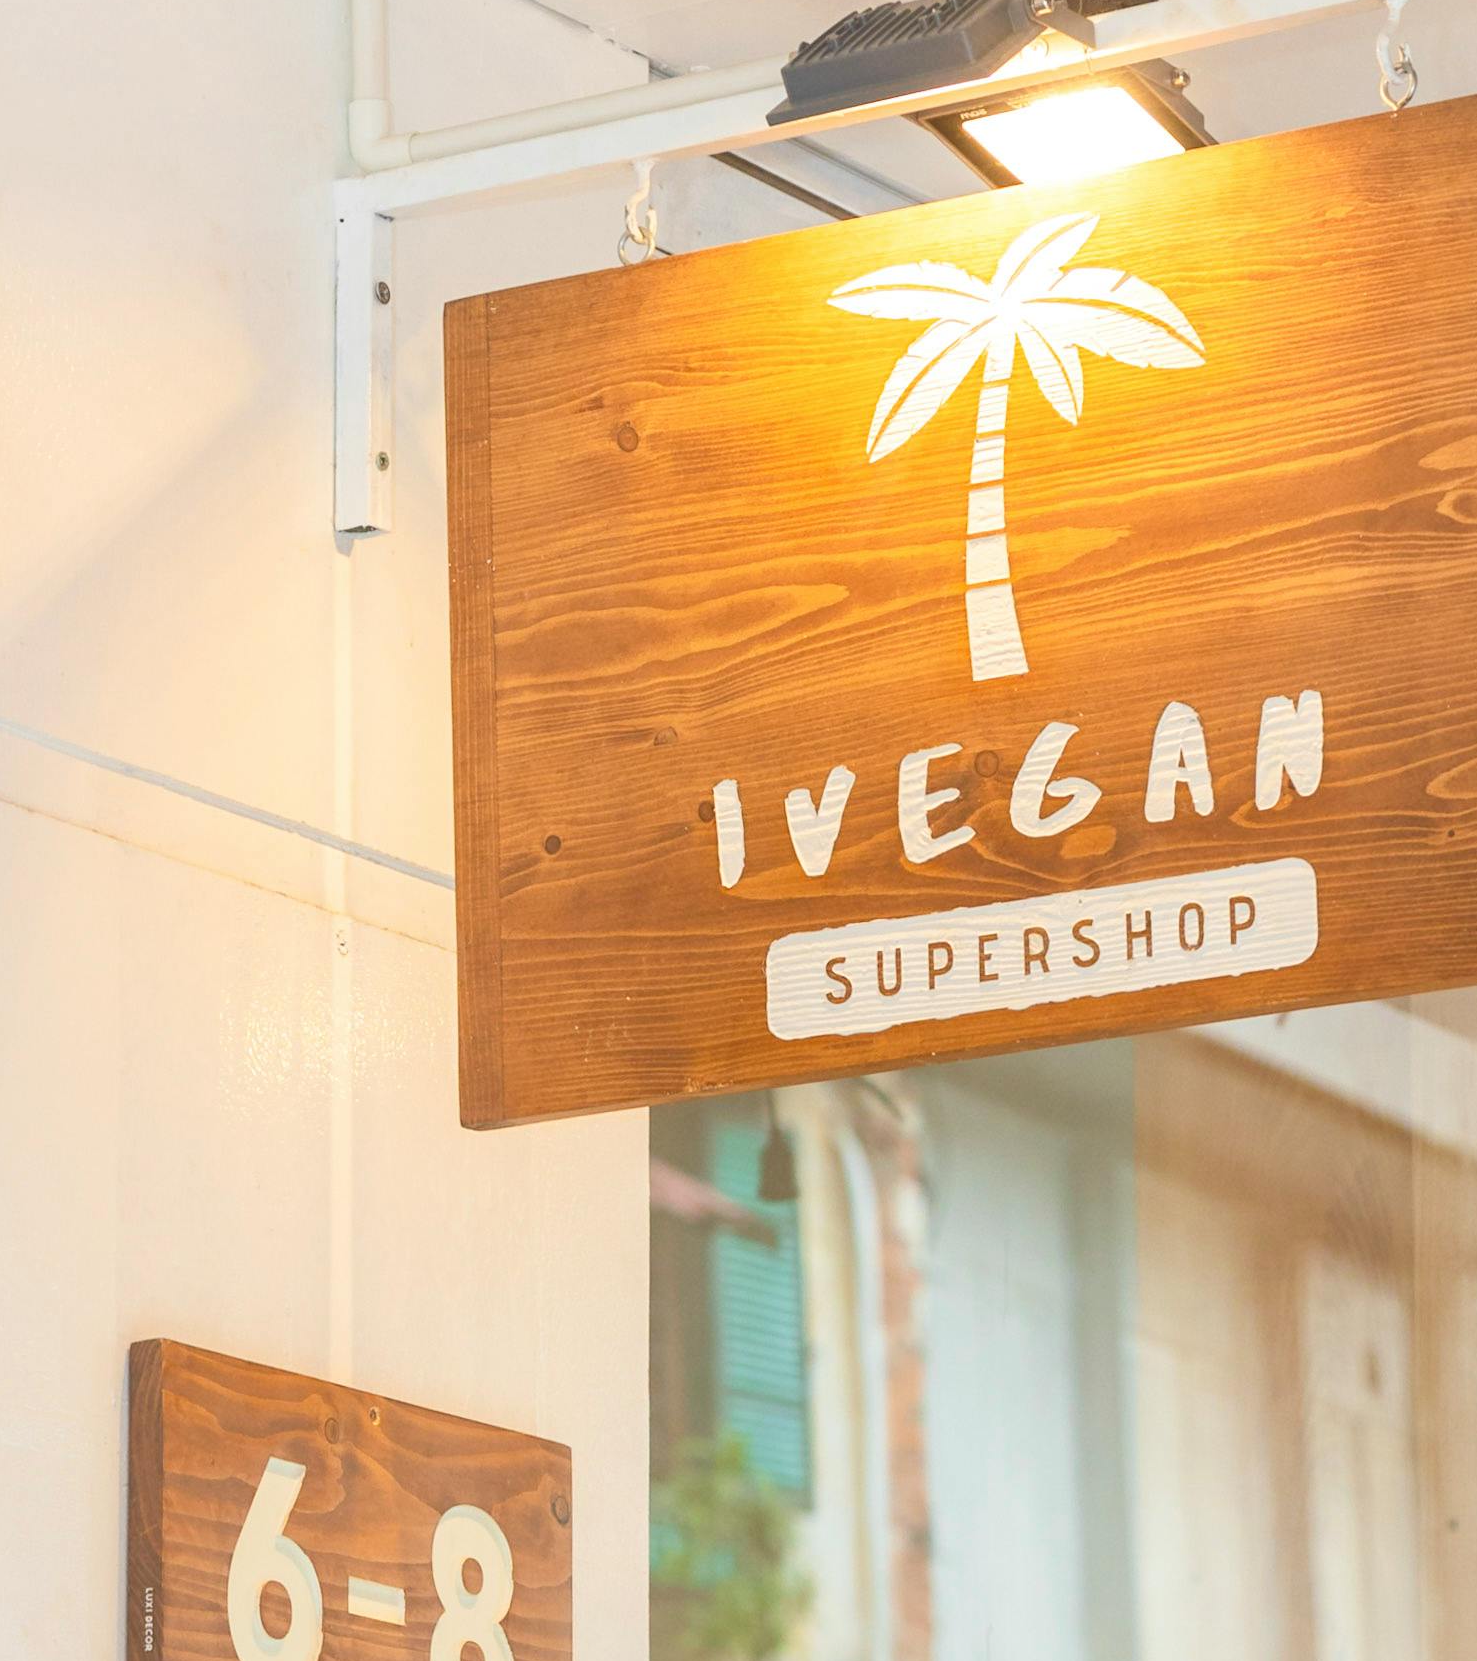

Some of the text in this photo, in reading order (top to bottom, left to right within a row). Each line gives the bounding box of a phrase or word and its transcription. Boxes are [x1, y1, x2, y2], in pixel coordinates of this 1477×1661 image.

[710, 689, 1325, 889] IVEGAN
[824, 895, 1262, 1006] SUPERSHOP
[144, 1587, 154, 1652] LUXI DECOR
